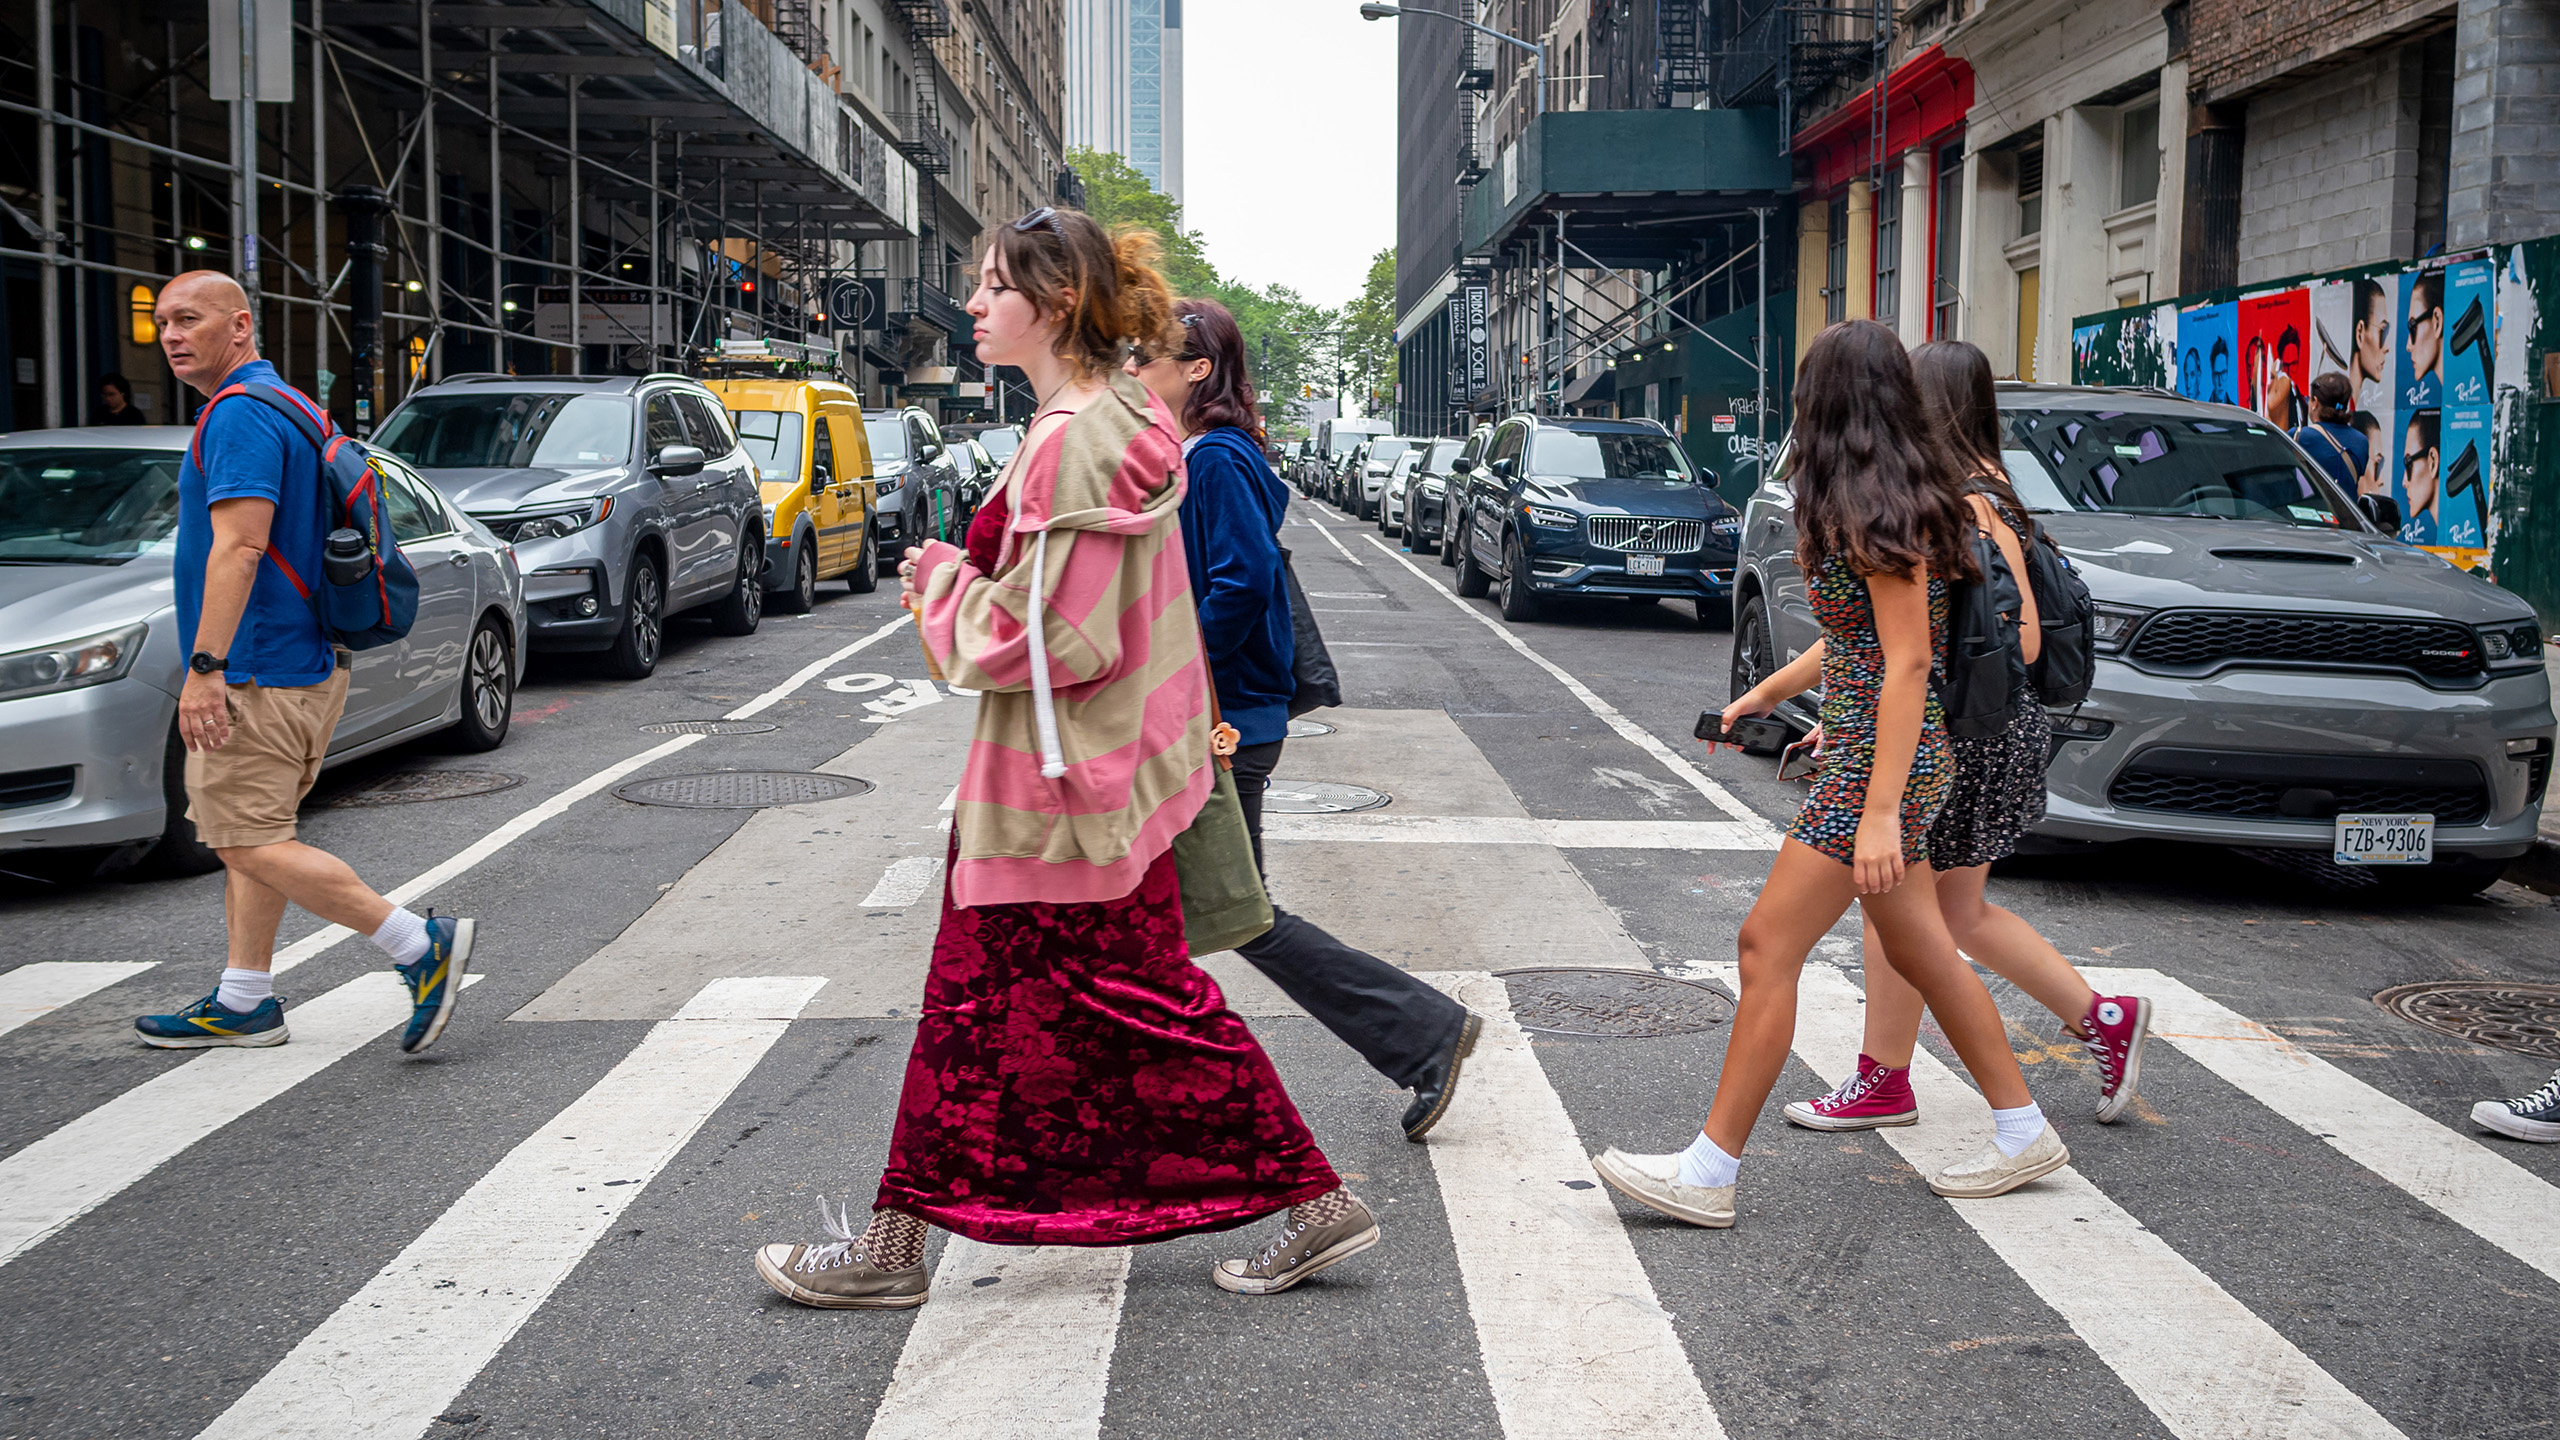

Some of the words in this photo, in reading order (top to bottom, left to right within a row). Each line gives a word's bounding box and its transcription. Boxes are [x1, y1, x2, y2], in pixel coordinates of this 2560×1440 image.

[840, 288, 865, 319] 17
[1470, 290, 1484, 325] TRIBECA
[1471, 346, 1485, 380] SOCIAL
[2361, 818, 2383, 826] NEW
[2385, 818, 2410, 826] YORK
